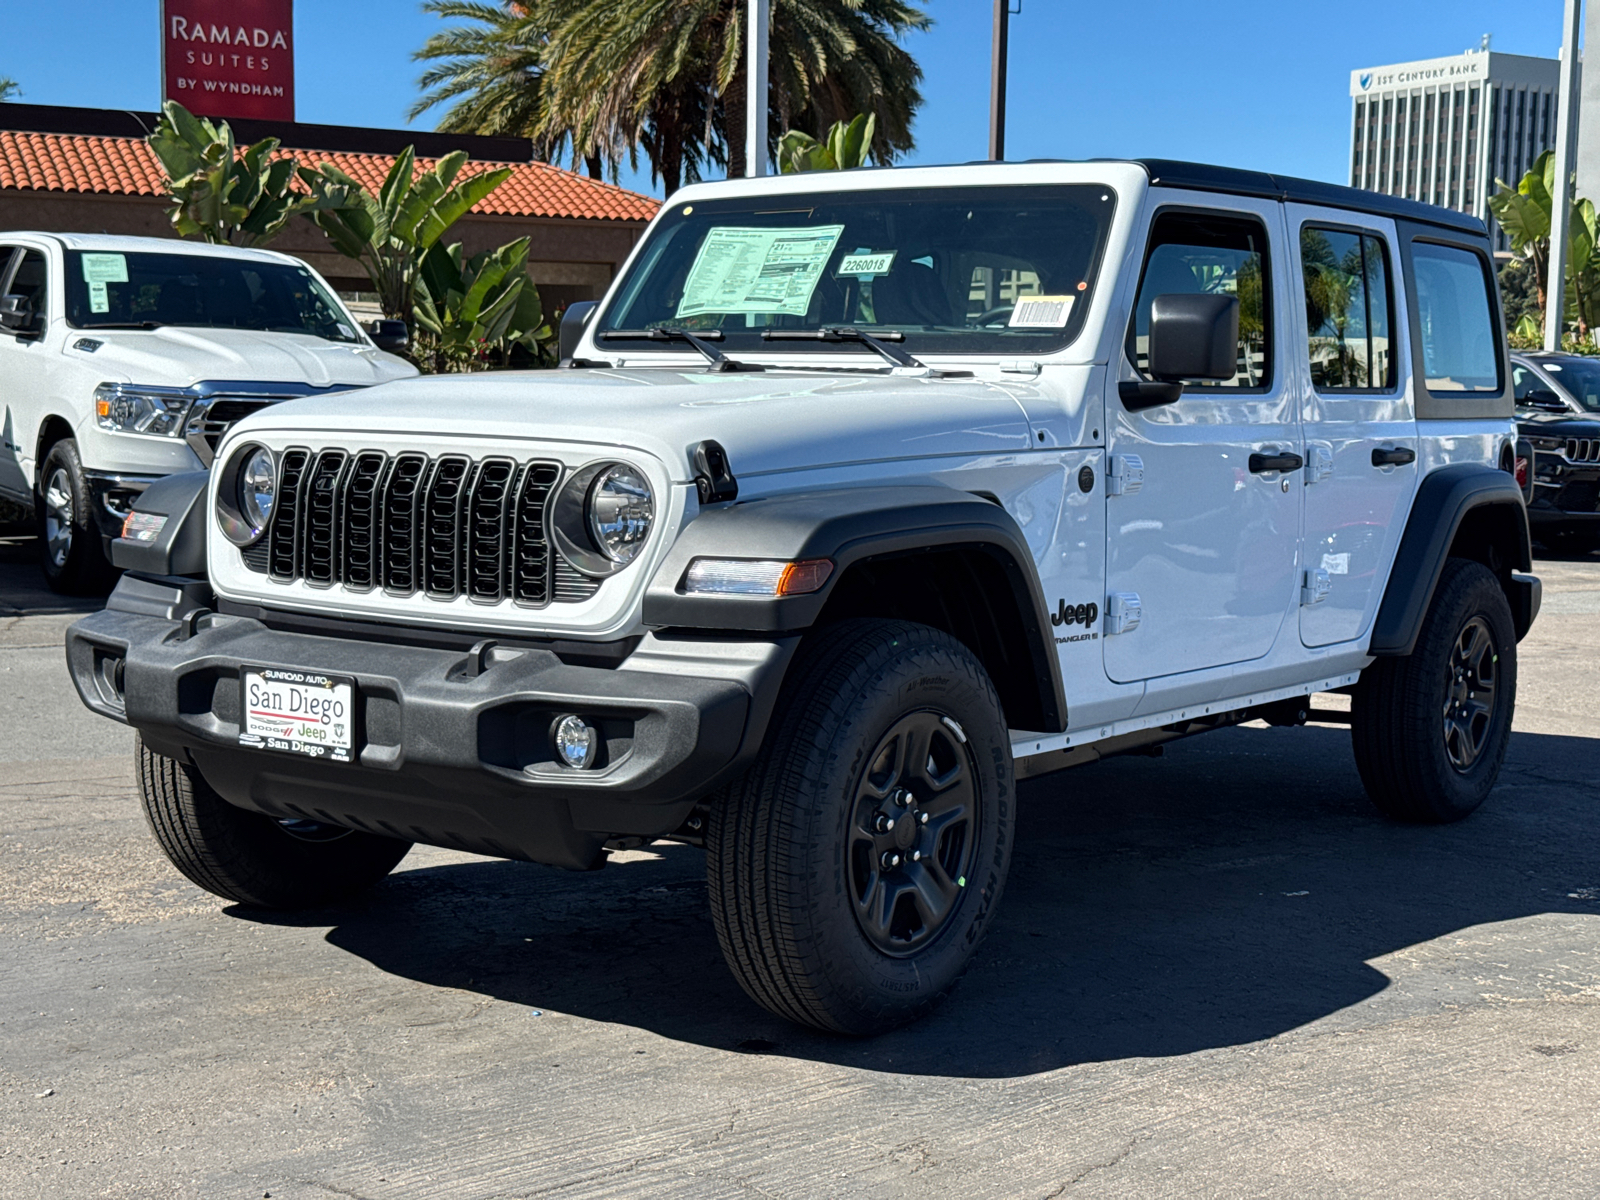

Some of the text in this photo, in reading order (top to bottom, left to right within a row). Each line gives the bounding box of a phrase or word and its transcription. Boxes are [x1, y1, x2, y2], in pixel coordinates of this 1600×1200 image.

[171, 15, 287, 50] RAMADA
[187, 50, 269, 71] SUITES
[1398, 67, 1445, 83] CENTURY
[1449, 64, 1477, 76] BANK
[177, 77, 284, 97] BY WYNDHAM
[843, 258, 886, 272] 2260018
[1051, 598, 1098, 629] Jeep
[265, 670, 328, 685] SUNROAD AUTO
[250, 683, 344, 726] San Diego
[250, 723, 327, 742] DODGE Jeep
[267, 737, 289, 750] San
[291, 740, 325, 757] Diego
